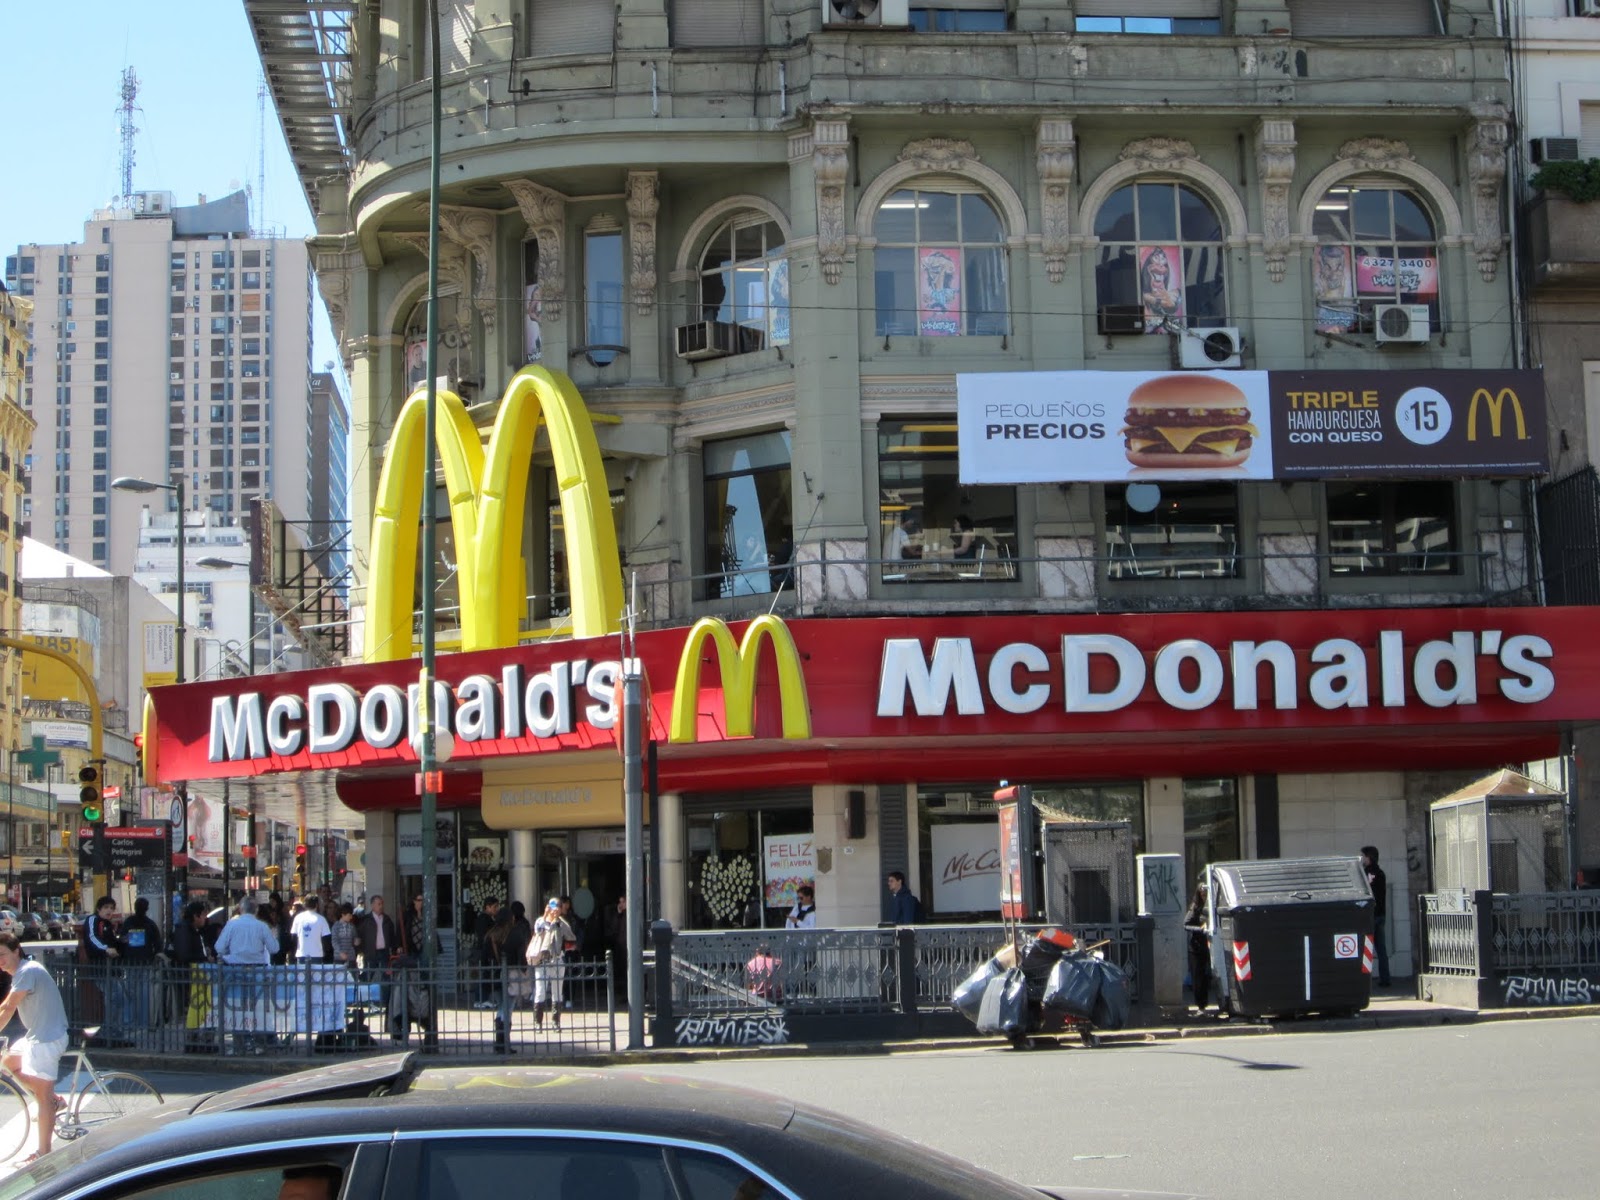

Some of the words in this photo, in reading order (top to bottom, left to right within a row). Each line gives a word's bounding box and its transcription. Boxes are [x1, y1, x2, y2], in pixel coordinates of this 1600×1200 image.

[1400, 259, 1433, 268] 3400
[1286, 390, 1379, 409] TRIPLE
[985, 401, 1106, 418] PEQUEÑOS
[1288, 409, 1382, 430] HAMBURGUESA
[986, 422, 1106, 440] PRECIOS
[1289, 431, 1324, 443] CON
[1328, 430, 1383, 443] QUESO
[876, 629, 1555, 718] McDonald's
[207, 657, 618, 763] McDonald's
[501, 787, 593, 807] McDonald's
[111, 838, 134, 846] Carlos
[769, 842, 812, 858] FELIZ
[111, 848, 143, 857] Pellegrini
[943, 848, 1001, 882] McCa
